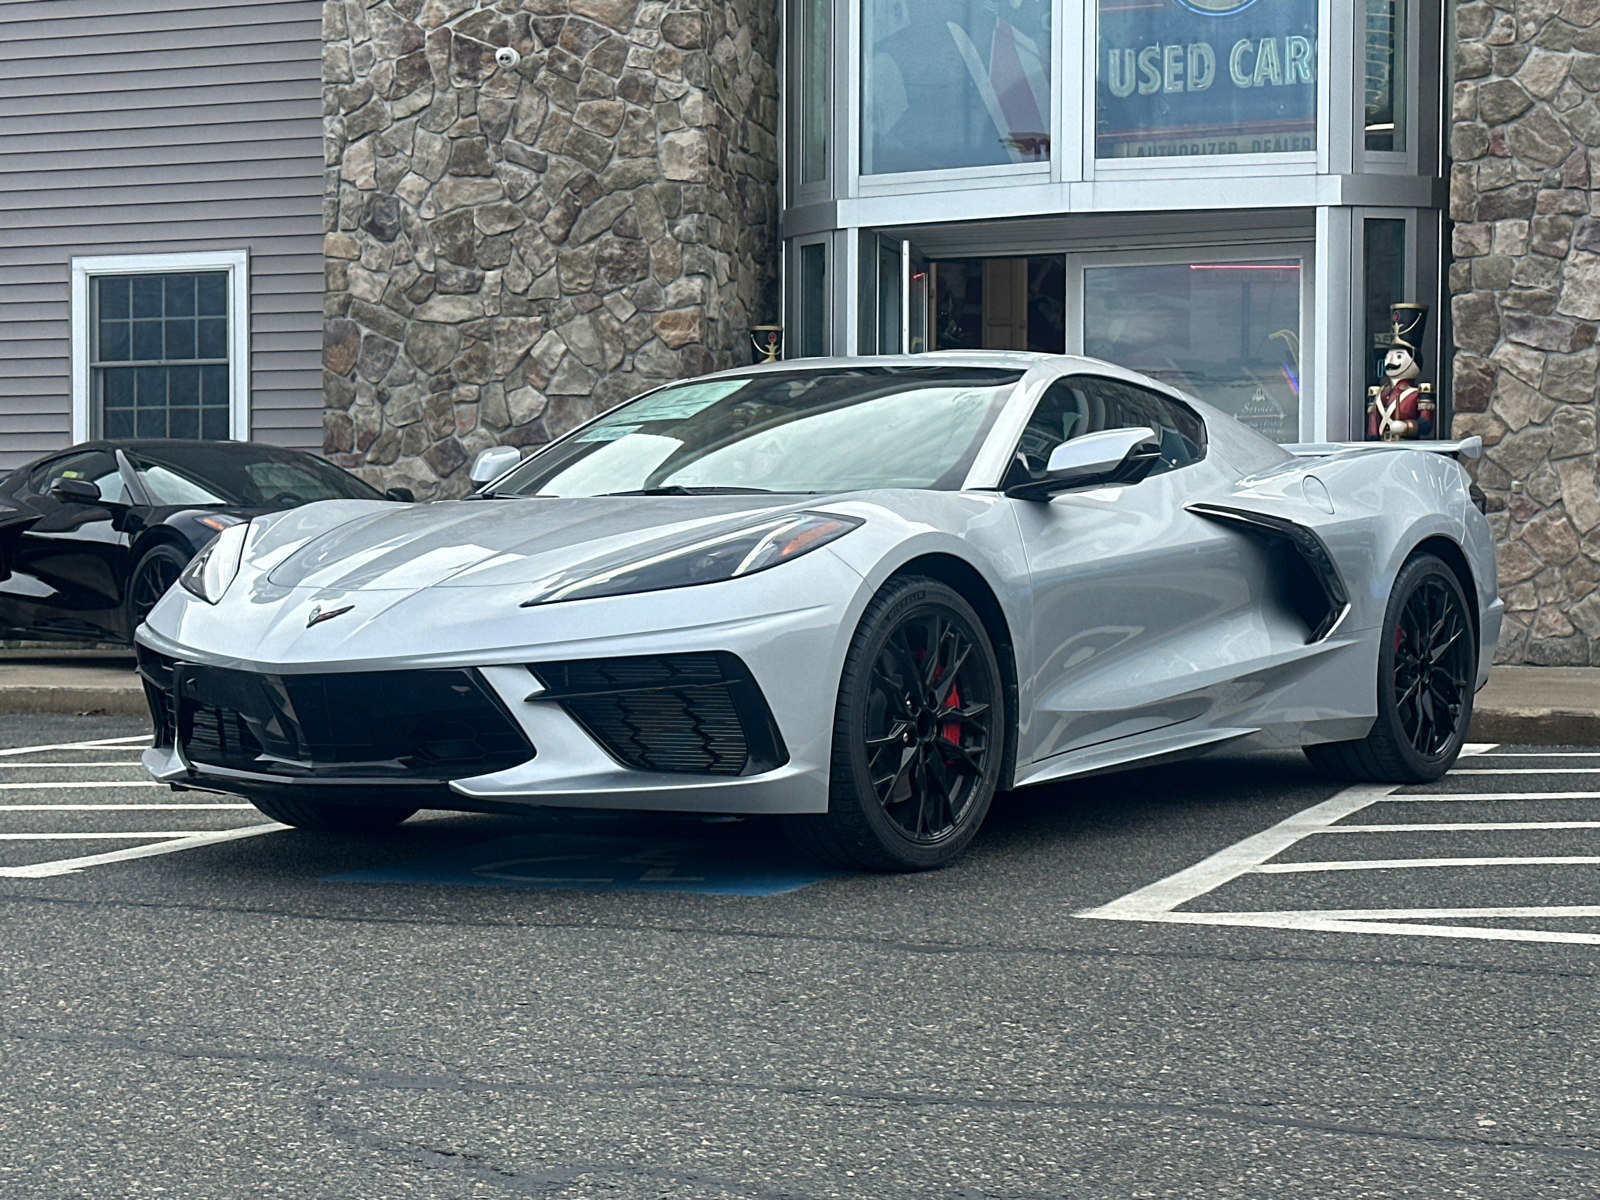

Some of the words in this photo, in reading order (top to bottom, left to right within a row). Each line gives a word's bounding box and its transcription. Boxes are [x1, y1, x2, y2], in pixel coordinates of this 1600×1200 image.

[1108, 42, 1216, 97] USED
[1229, 35, 1317, 88] CAR
[1137, 141, 1238, 157] AUTHORIZED
[1252, 137, 1311, 152] DEALER
